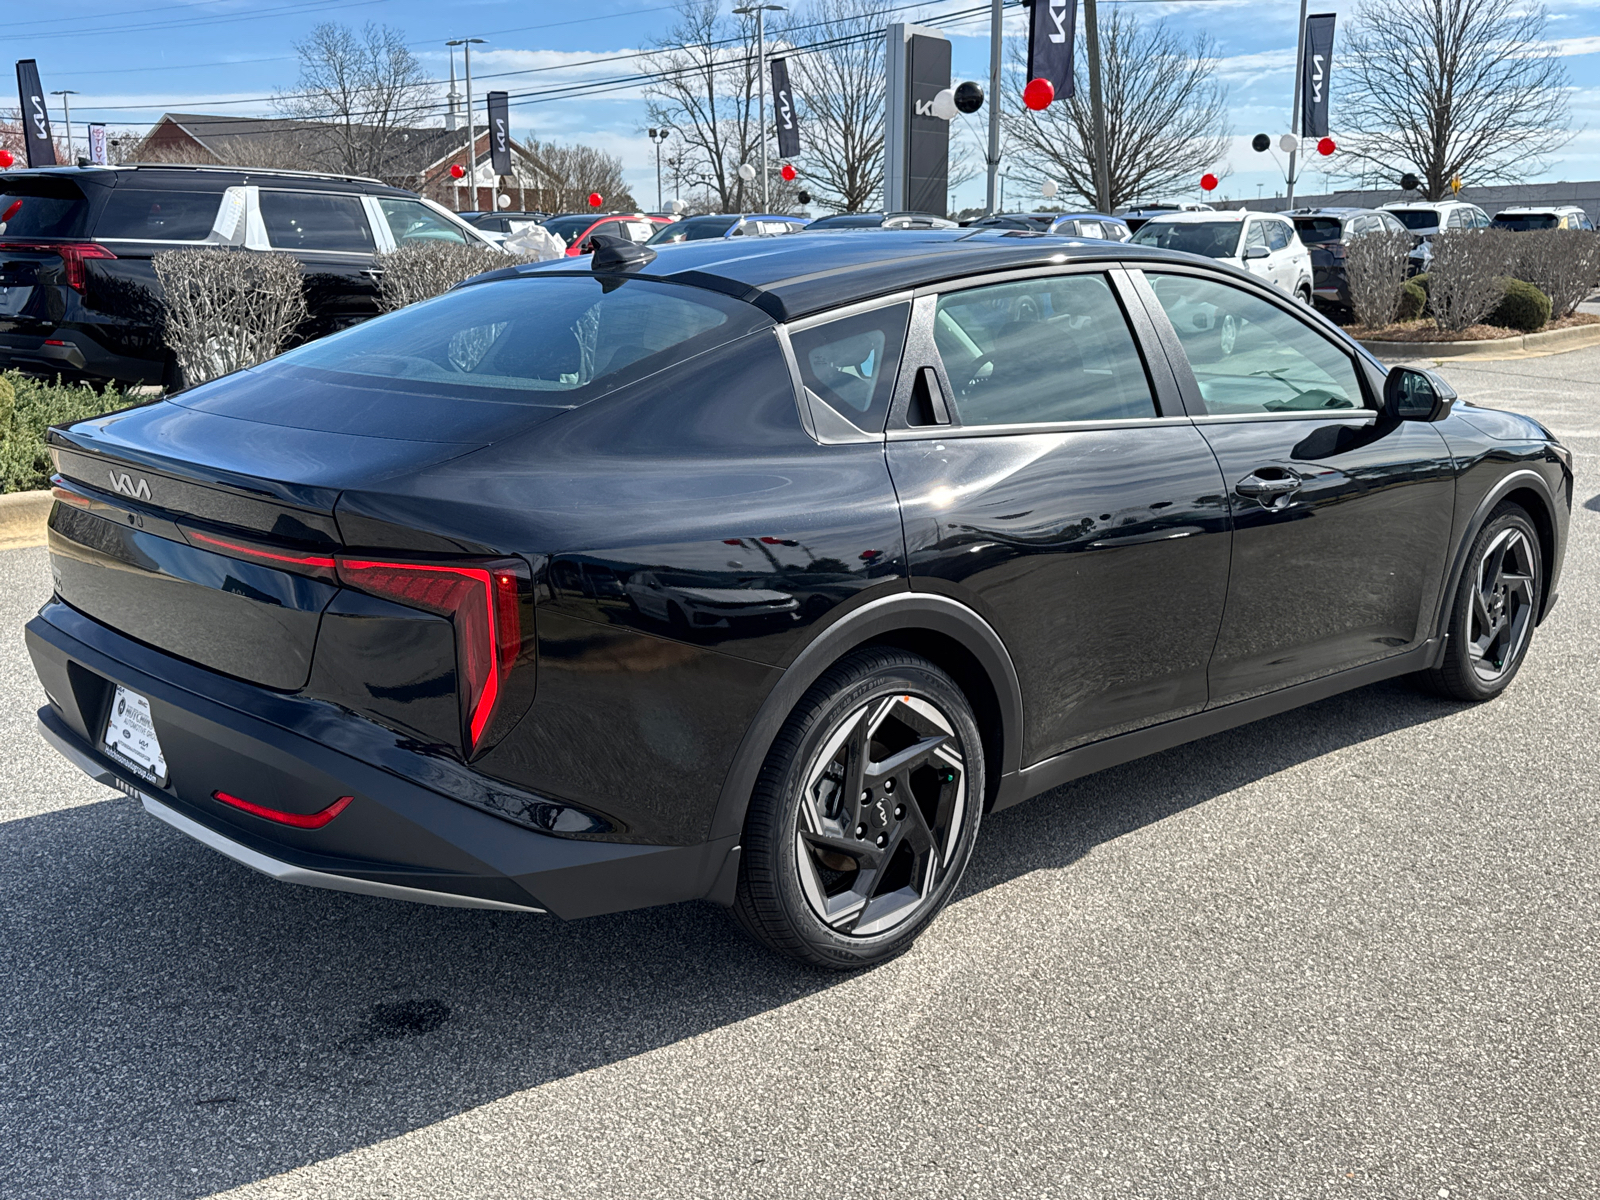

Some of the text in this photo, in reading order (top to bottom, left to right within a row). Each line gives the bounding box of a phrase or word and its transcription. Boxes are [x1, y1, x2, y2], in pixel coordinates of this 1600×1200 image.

[1048, 0, 1066, 44] KI
[1312, 54, 1325, 103] KIA
[31, 95, 48, 139] KIA
[779, 90, 793, 130] KIA
[495, 118, 506, 153] KIA
[109, 469, 152, 501] KIA
[876, 801, 888, 826] KIA
